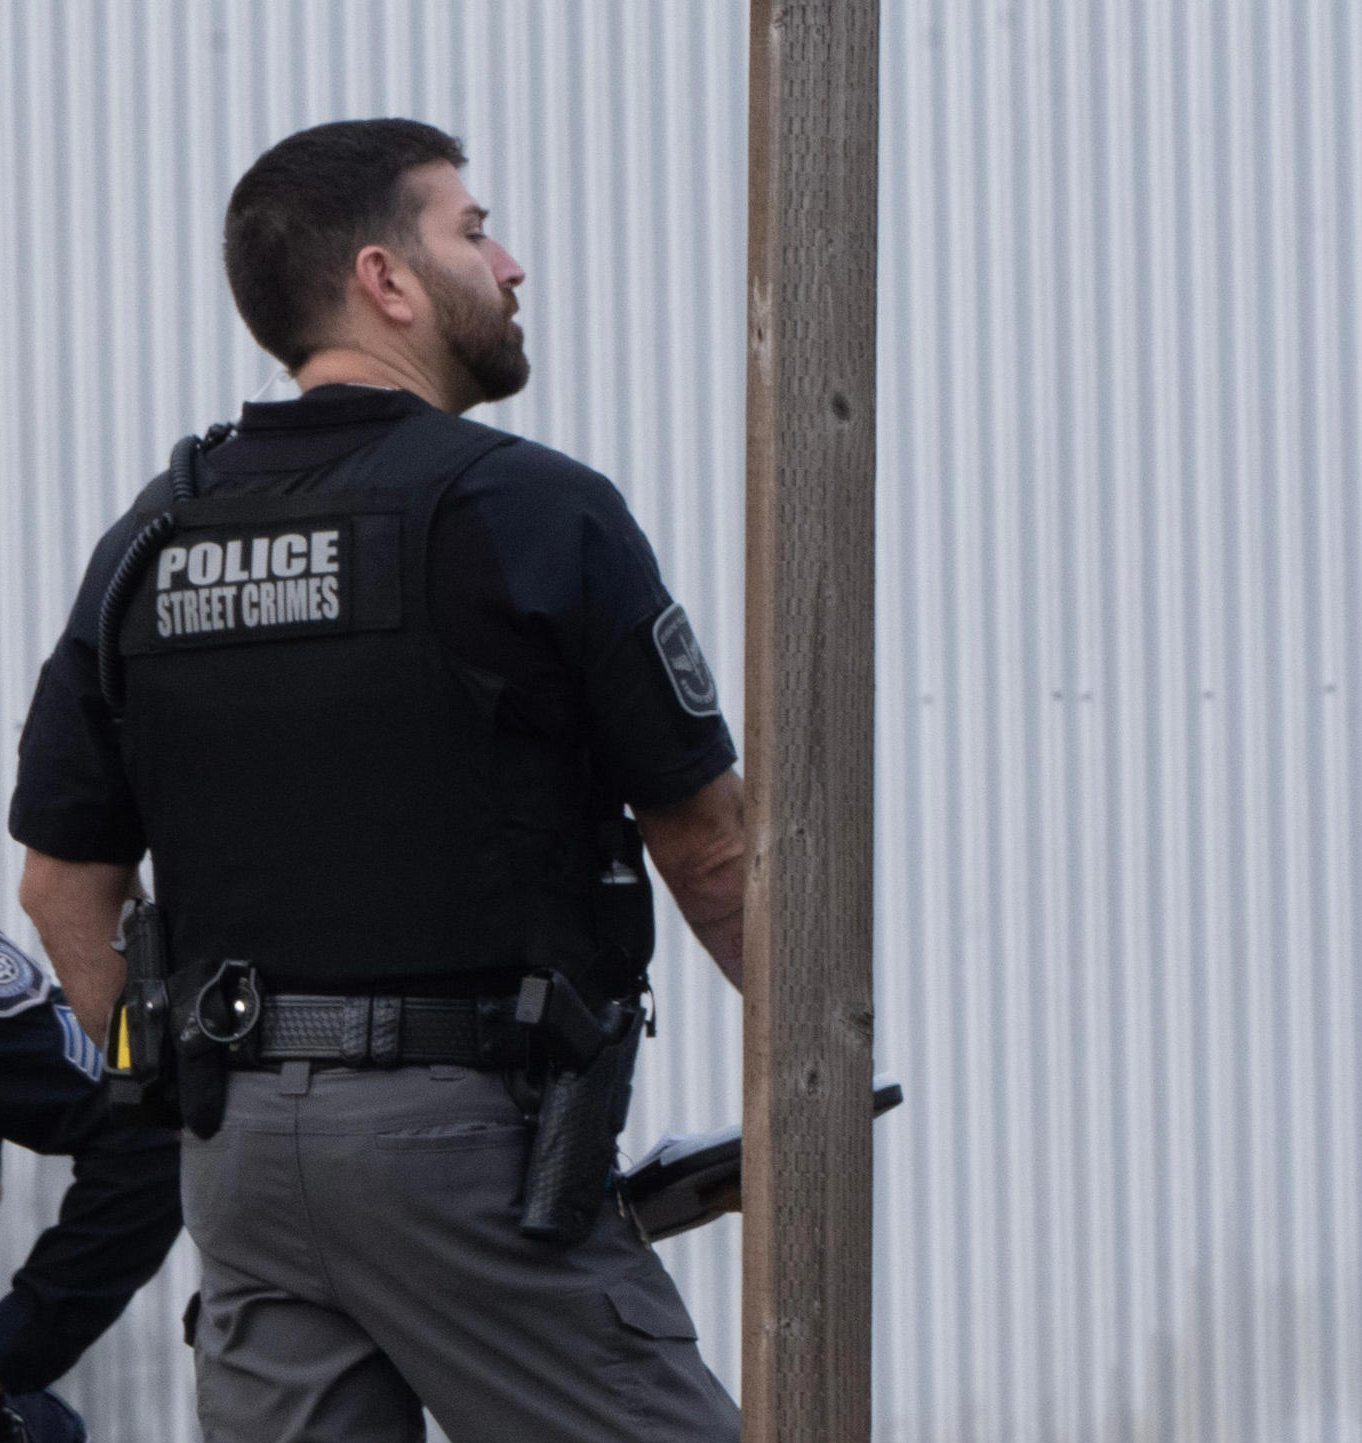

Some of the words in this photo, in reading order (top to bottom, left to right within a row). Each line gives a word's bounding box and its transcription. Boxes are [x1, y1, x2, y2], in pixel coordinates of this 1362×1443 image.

[157, 530, 339, 590] POLICE
[157, 585, 237, 638] STREET
[241, 575, 339, 627] CRIMES
